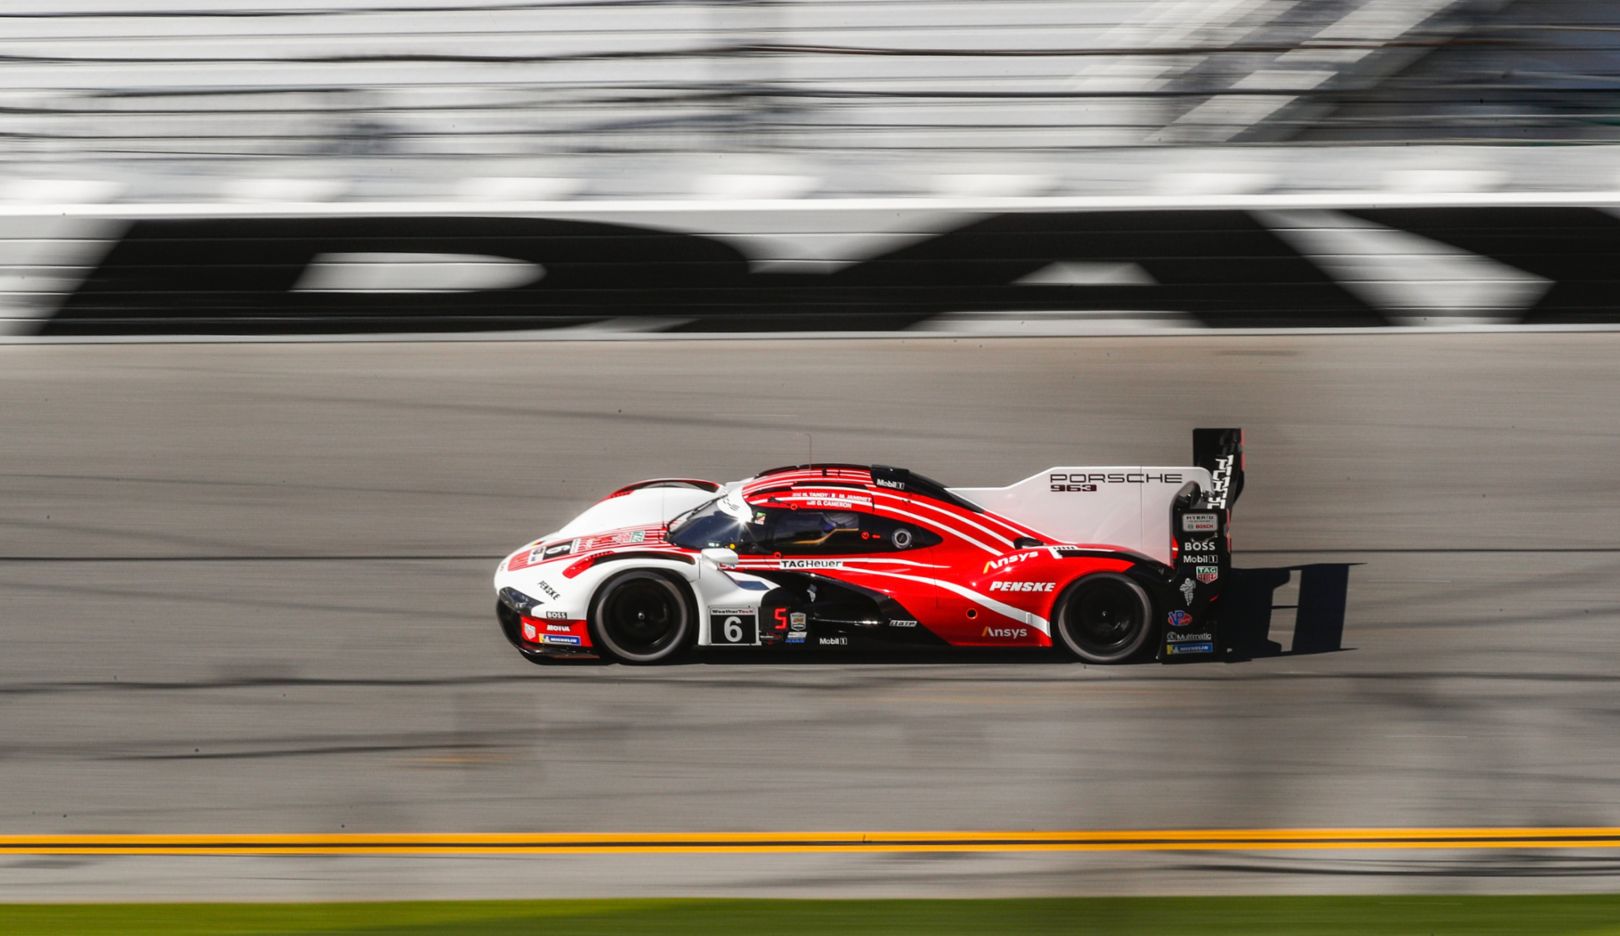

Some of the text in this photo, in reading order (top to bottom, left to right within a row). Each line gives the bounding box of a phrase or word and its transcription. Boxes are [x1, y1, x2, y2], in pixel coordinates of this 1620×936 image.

[877, 478, 896, 488] Mobil
[1050, 473, 1182, 484] PORSCHE
[1050, 484, 1097, 492] 963
[1184, 541, 1216, 551] BOSS
[983, 551, 1039, 574] Ansys
[1183, 555, 1208, 563] Mobil
[537, 580, 560, 600] PENSKE
[989, 581, 1056, 592] PENSKE
[547, 611, 567, 619] BOSS
[774, 607, 788, 629] 5
[724, 616, 743, 642] 6
[981, 626, 1028, 639] Ansys
[820, 637, 839, 645] Mobil
